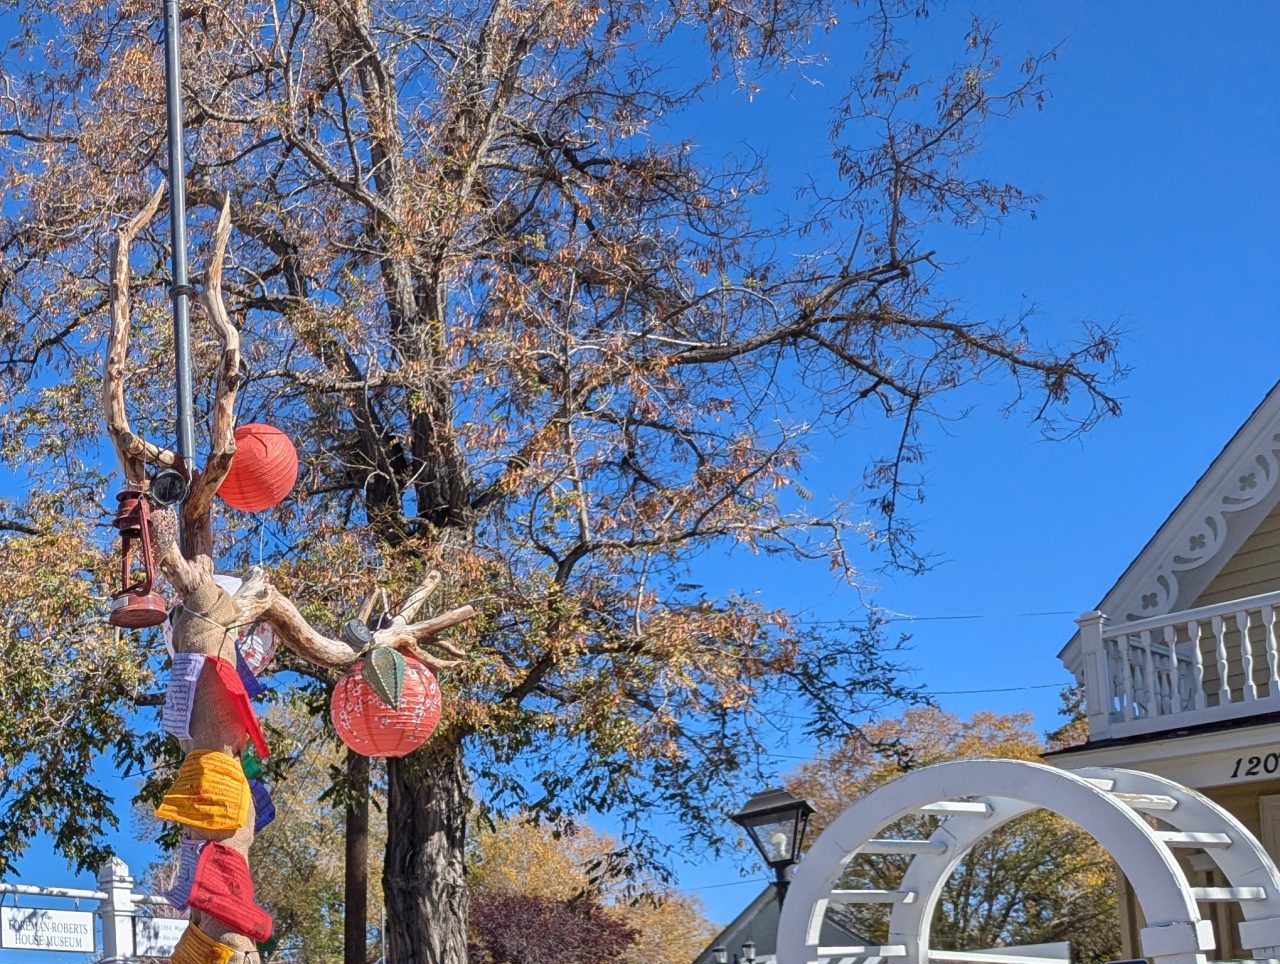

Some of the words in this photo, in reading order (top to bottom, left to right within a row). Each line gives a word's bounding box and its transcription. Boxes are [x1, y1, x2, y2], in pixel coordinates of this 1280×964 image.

[1230, 752, 1280, 778] 120
[9, 919, 88, 935] FOREMAN-ROBERTS
[15, 934, 44, 946] HOUSE
[46, 935, 82, 948] MUSEUM
